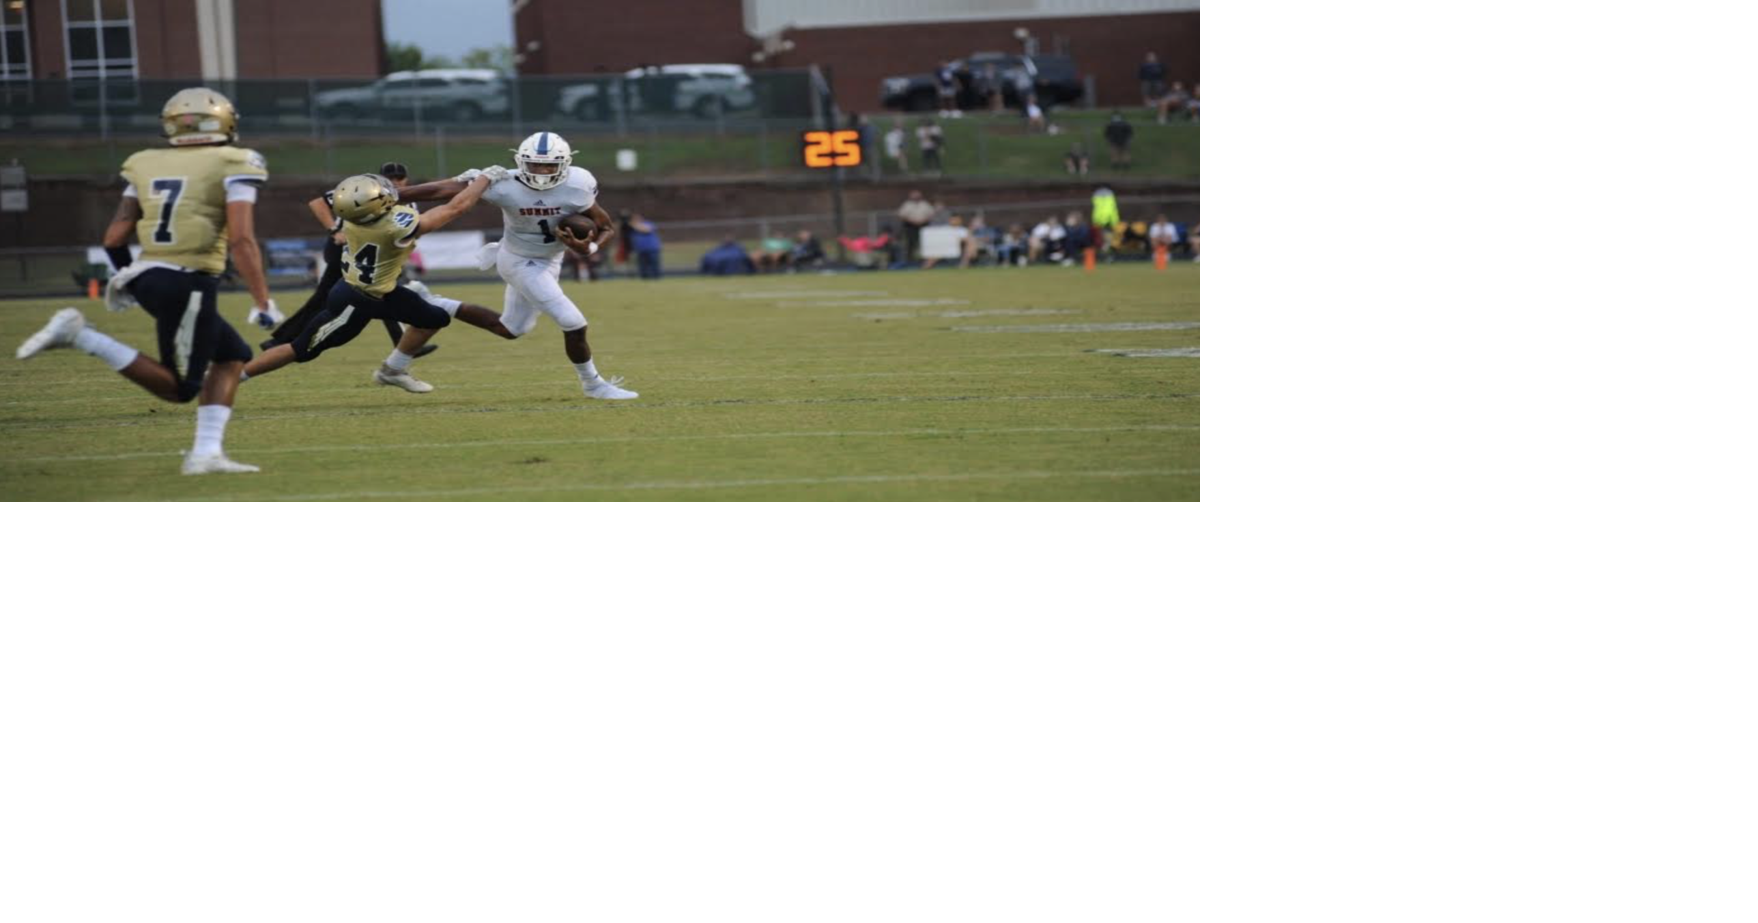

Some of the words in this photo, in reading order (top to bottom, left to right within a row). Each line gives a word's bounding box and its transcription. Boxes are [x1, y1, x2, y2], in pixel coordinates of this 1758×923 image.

[805, 130, 860, 167] 25
[151, 177, 186, 243] 7
[519, 206, 561, 216] SUMMIT
